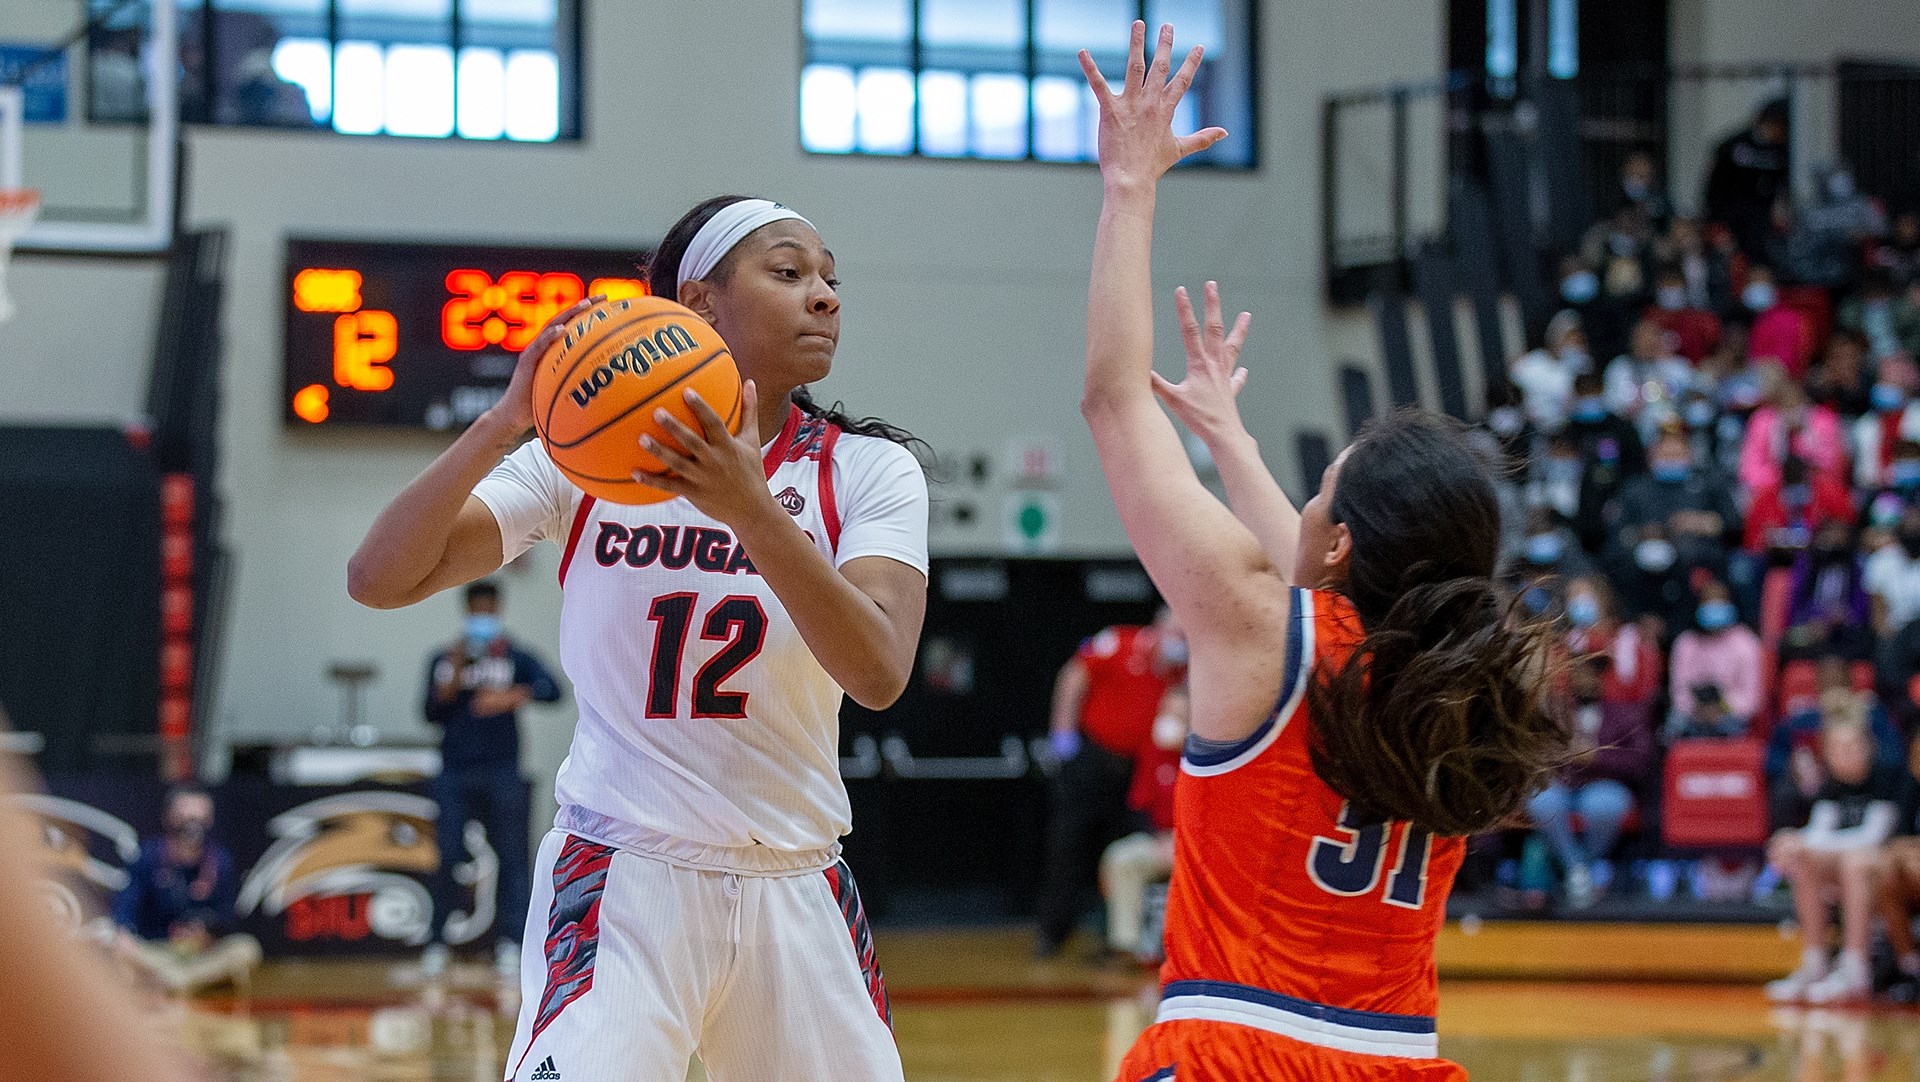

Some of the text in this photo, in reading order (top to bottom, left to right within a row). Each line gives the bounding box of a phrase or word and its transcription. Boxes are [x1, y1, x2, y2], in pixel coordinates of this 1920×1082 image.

[569, 322, 701, 410] Wilson
[595, 521, 815, 576] COUGA
[645, 591, 768, 719] 12
[1305, 799, 1434, 910] 31
[531, 1070, 561, 1081] adidas
